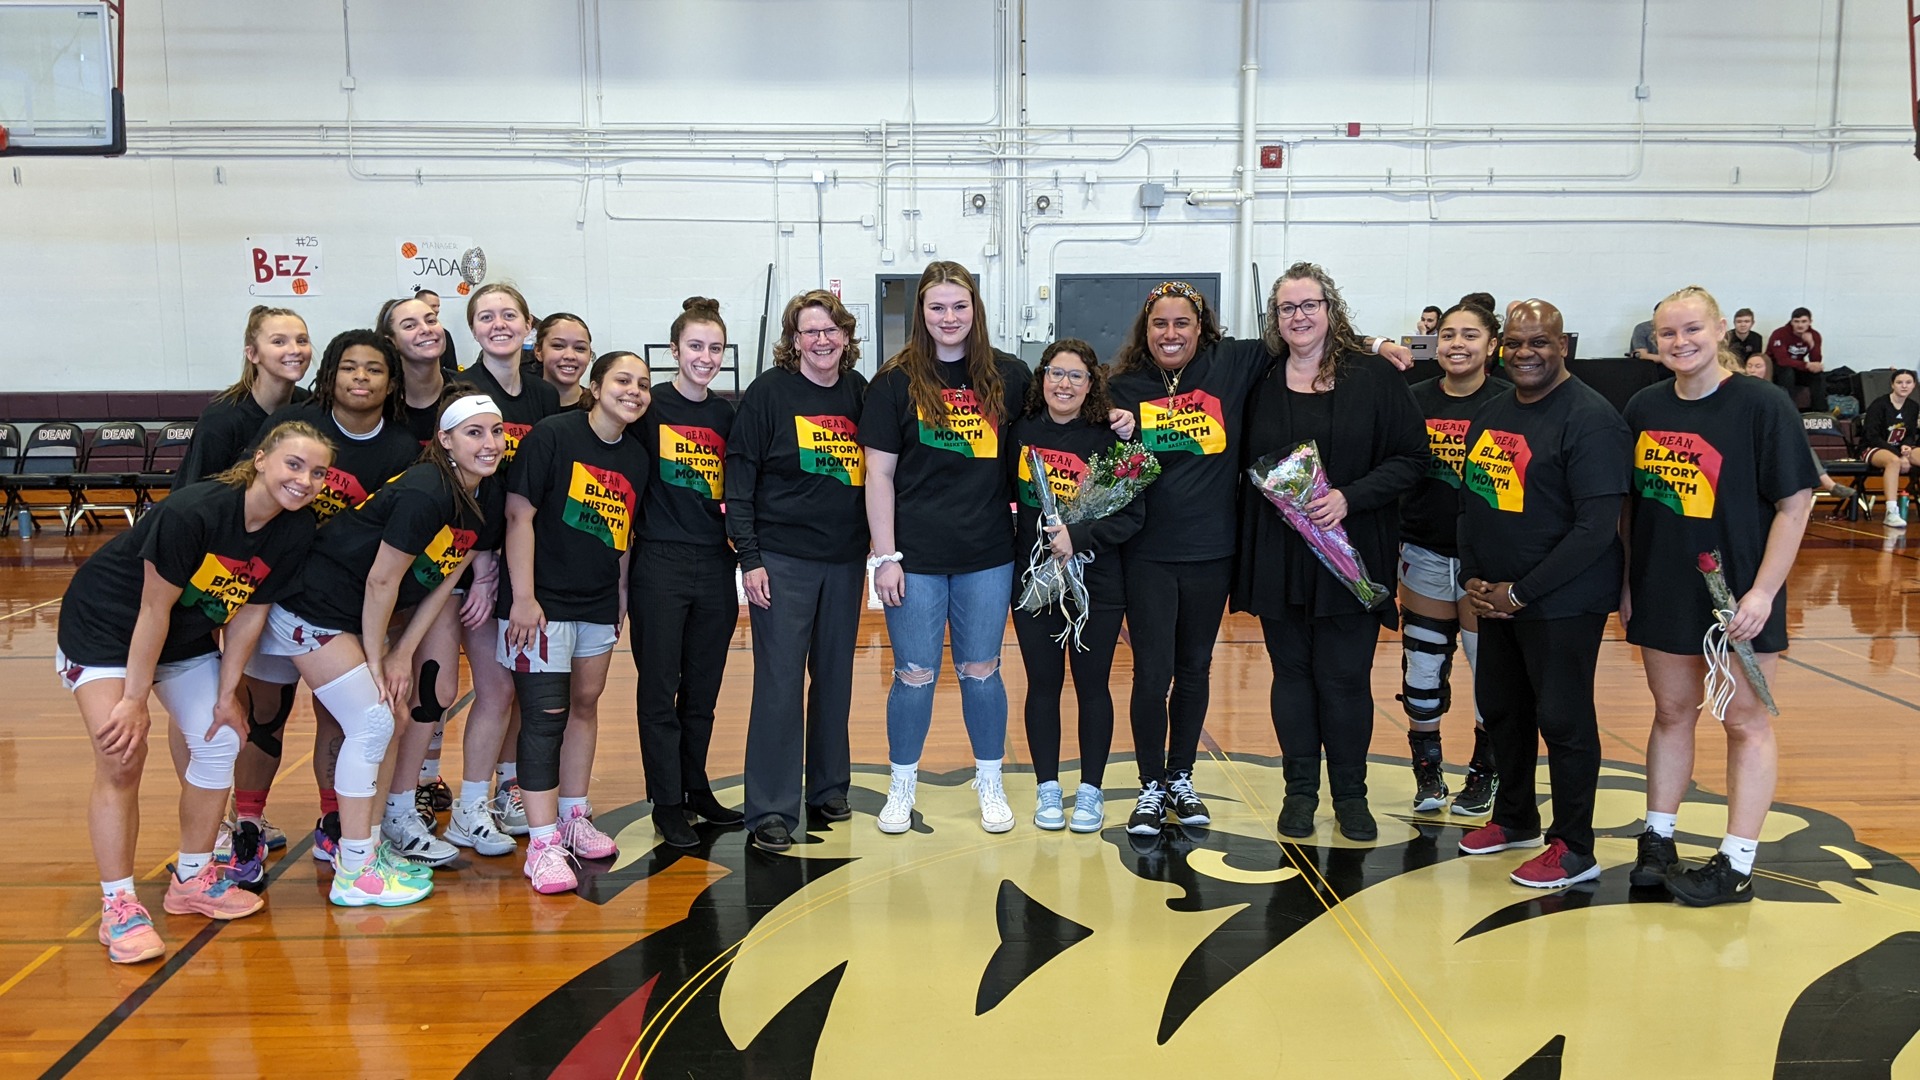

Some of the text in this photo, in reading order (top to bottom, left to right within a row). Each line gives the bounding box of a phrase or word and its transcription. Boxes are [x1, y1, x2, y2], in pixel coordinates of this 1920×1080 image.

[296, 236, 318, 247] #25
[421, 242, 458, 250] MANAGER
[252, 248, 311, 283] BEZ
[414, 258, 462, 276] JADA
[821, 418, 848, 429] DEAN
[1156, 415, 1206, 431] HISTORY
[1435, 422, 1465, 432] DEAN
[1803, 418, 1832, 429] DEAN
[38, 429, 72, 440] DEAN
[102, 429, 135, 440] DEAN
[167, 428, 194, 440] DEA
[686, 430, 710, 442] DEAN
[812, 432, 856, 442] BLACK
[934, 430, 982, 440] MONTH
[1156, 426, 1210, 444] MONTH
[676, 442, 720, 456] BLACK
[1494, 436, 1518, 448] DEAN
[1658, 436, 1694, 449] DEAN
[814, 445, 858, 454] HISTORY
[1480, 446, 1520, 462] BLACK
[675, 456, 720, 468] HISTORY
[816, 456, 860, 468] MONTH
[1044, 454, 1072, 468] DEAN
[1644, 448, 1703, 466] BLACK
[675, 468, 720, 481] MONTH
[1474, 460, 1513, 475] HISTORY
[1644, 465, 1699, 479] HISTORY
[325, 471, 350, 490] EAN
[597, 474, 620, 488] DEAN
[1048, 467, 1080, 483] ACK
[1472, 472, 1510, 490] MONTH
[1050, 481, 1078, 493] TORY
[1643, 478, 1698, 495] MONTH
[321, 486, 355, 504] ACK
[585, 484, 628, 504] BLACK
[582, 498, 626, 516] HISTORY
[578, 512, 624, 530] MONTH
